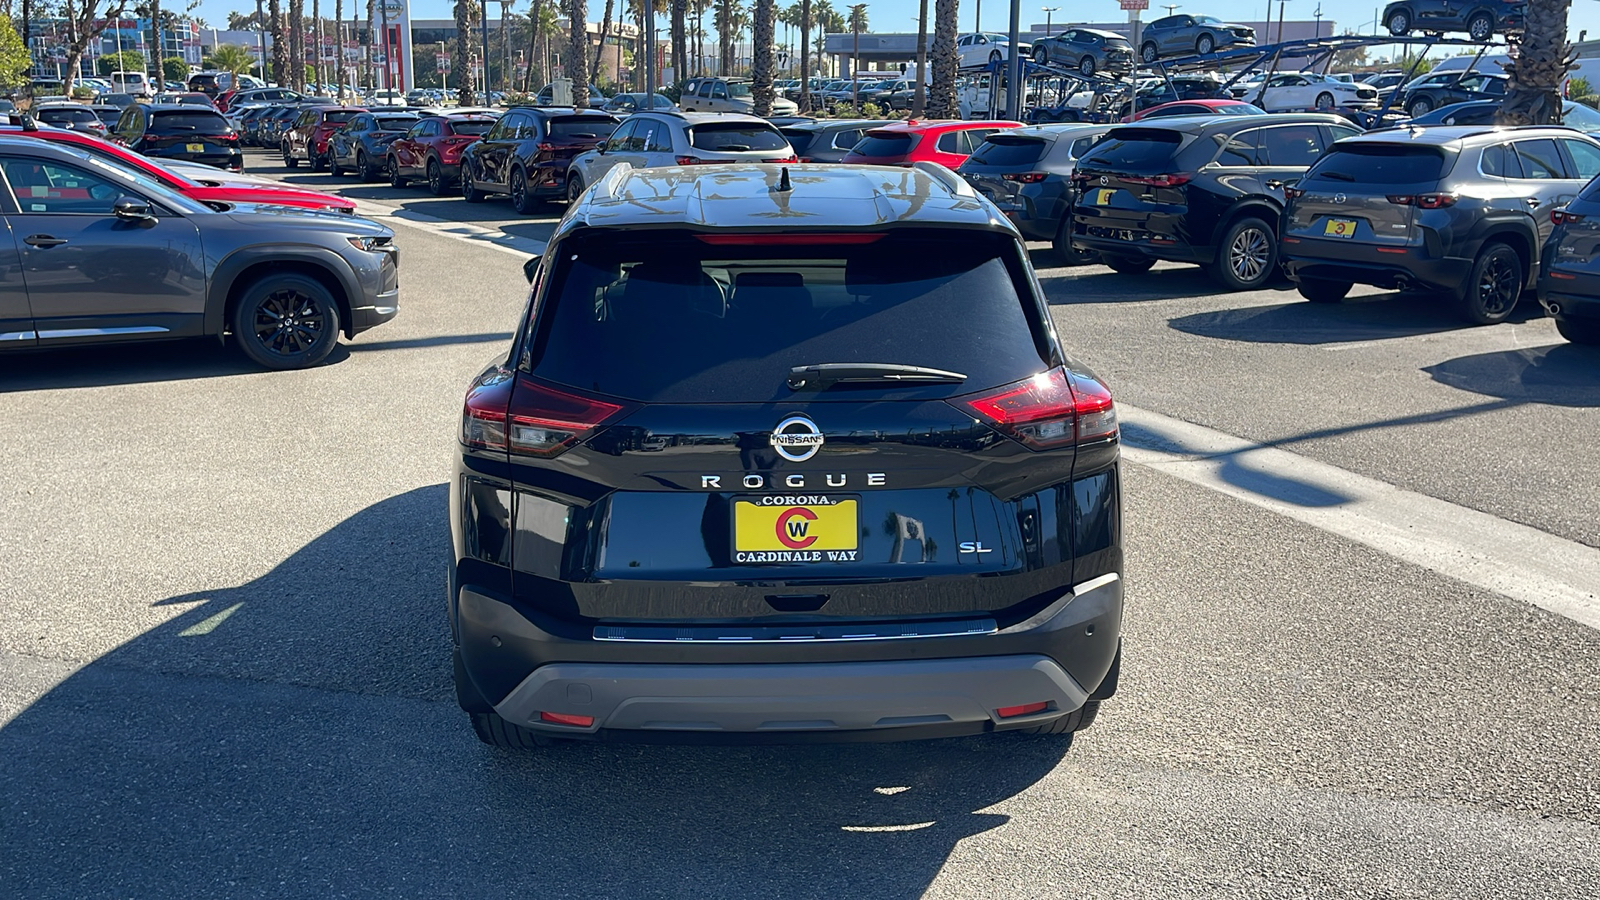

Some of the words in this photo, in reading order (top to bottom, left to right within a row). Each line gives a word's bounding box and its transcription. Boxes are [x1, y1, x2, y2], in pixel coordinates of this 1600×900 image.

[776, 436, 818, 444] NISSAN
[701, 473, 886, 489] ROGUE
[762, 495, 830, 506] CORONA
[959, 541, 993, 553] SL
[736, 551, 822, 563] CARDINALE
[827, 550, 858, 561] WAY
